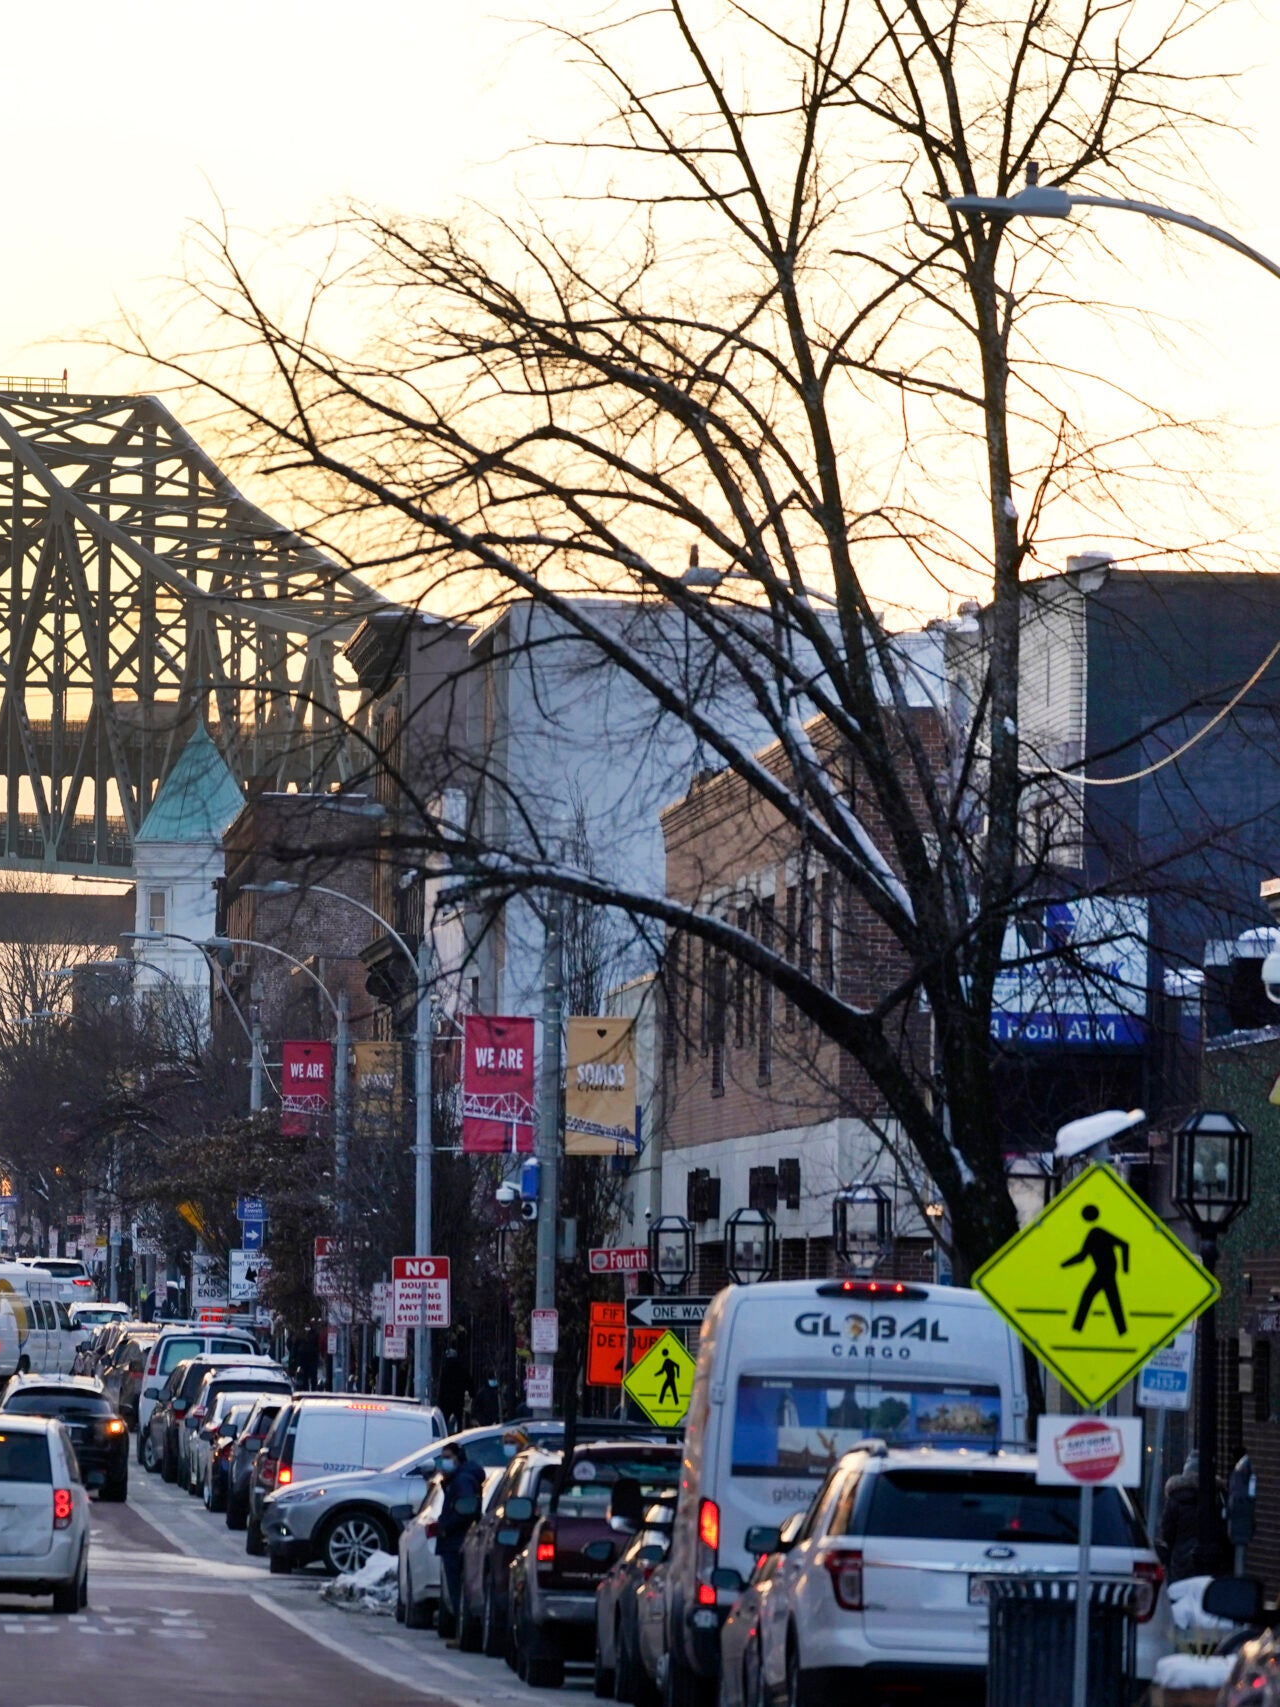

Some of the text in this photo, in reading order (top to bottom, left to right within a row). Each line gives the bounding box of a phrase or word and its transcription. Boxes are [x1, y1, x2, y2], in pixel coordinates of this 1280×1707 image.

[1067, 1021, 1116, 1041] ATM
[474, 1048, 524, 1069] WE ARE
[290, 1063, 324, 1078] WE ARE
[576, 1062, 625, 1086] SOMOS
[405, 1260, 436, 1277] NO
[609, 1251, 648, 1269] Fourth
[197, 1288, 224, 1298] ENDS
[397, 1314, 444, 1322] $100 INE
[652, 1305, 707, 1319] ONE WAY
[794, 1312, 950, 1343] GLOBAL
[831, 1343, 911, 1360] CARGO
